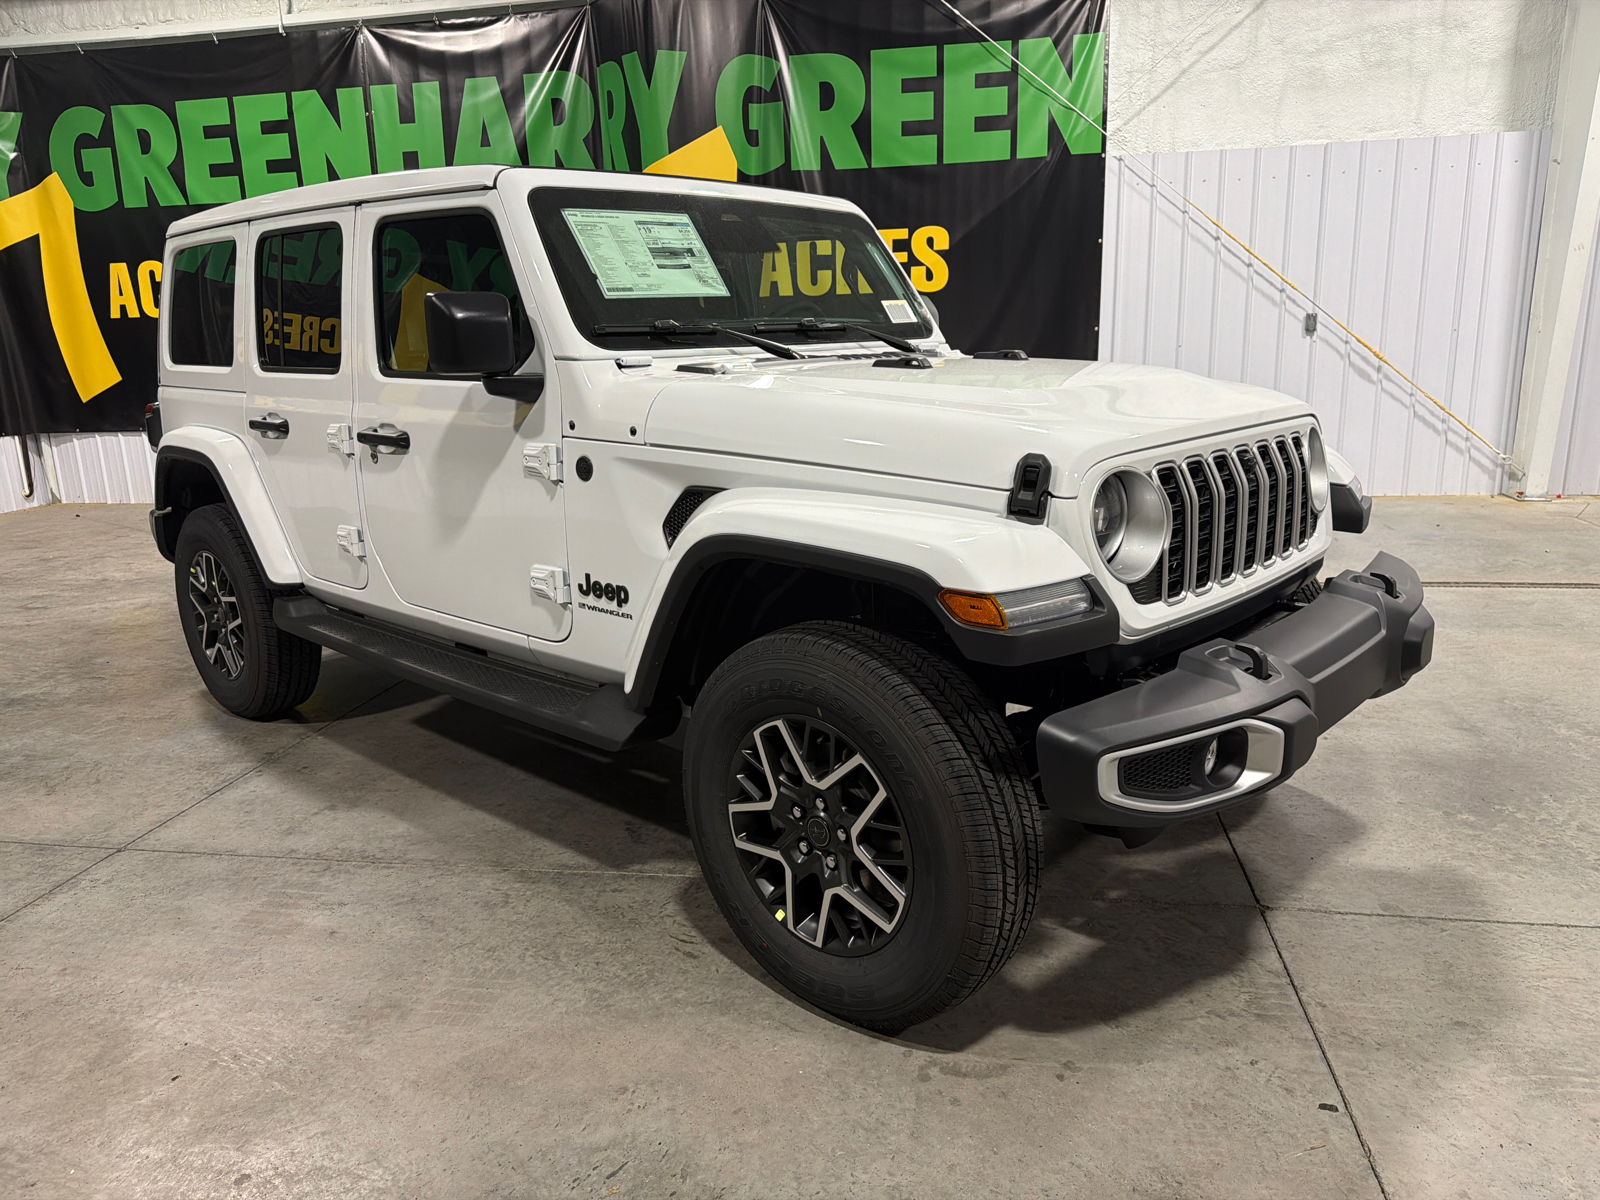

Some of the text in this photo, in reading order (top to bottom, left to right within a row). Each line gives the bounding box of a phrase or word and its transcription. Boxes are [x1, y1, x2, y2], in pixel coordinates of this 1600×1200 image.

[715, 32, 1106, 177] GREEN
[577, 572, 629, 609] Jeep
[586, 603, 634, 621] WRANGLER
